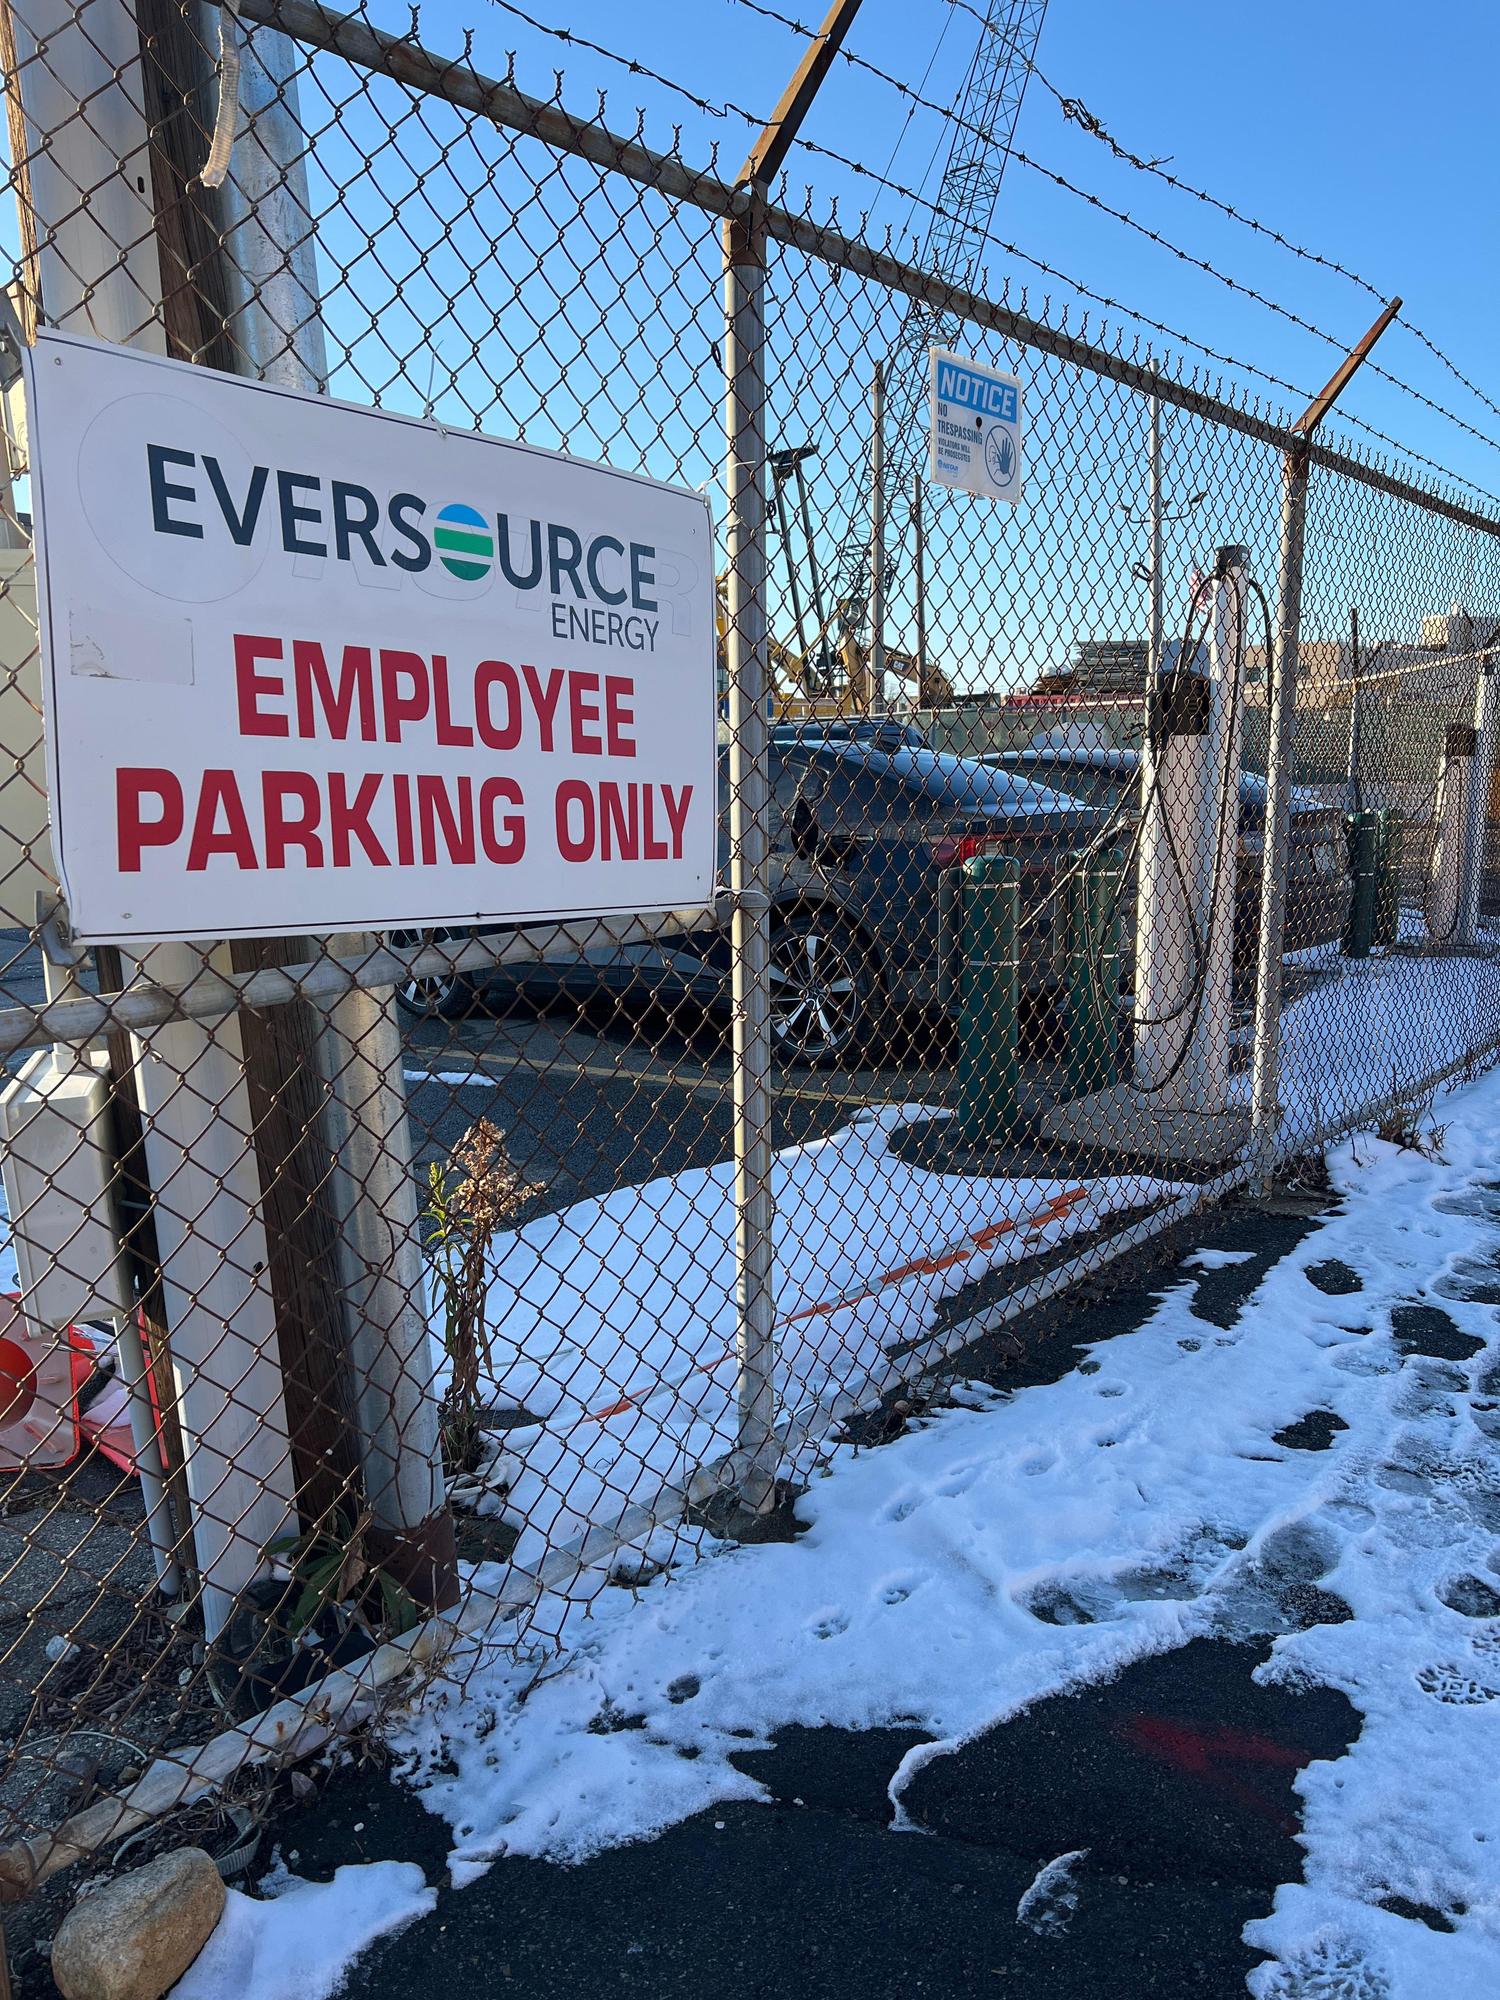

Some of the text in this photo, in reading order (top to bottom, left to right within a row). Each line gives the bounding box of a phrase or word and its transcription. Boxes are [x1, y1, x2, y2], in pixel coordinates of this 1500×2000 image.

[938, 402, 948, 417] NO
[940, 367, 1015, 417] NOTICE
[937, 419, 983, 445] TRESPASSING
[938, 446, 971, 462] BE PROSECUTED
[961, 444, 971, 454] WILL
[146, 443, 658, 611] EVERSOURCE
[552, 602, 660, 652] ENERGY
[233, 633, 637, 758] EMPLOYEE
[116, 767, 694, 873] PARKING ONLY
